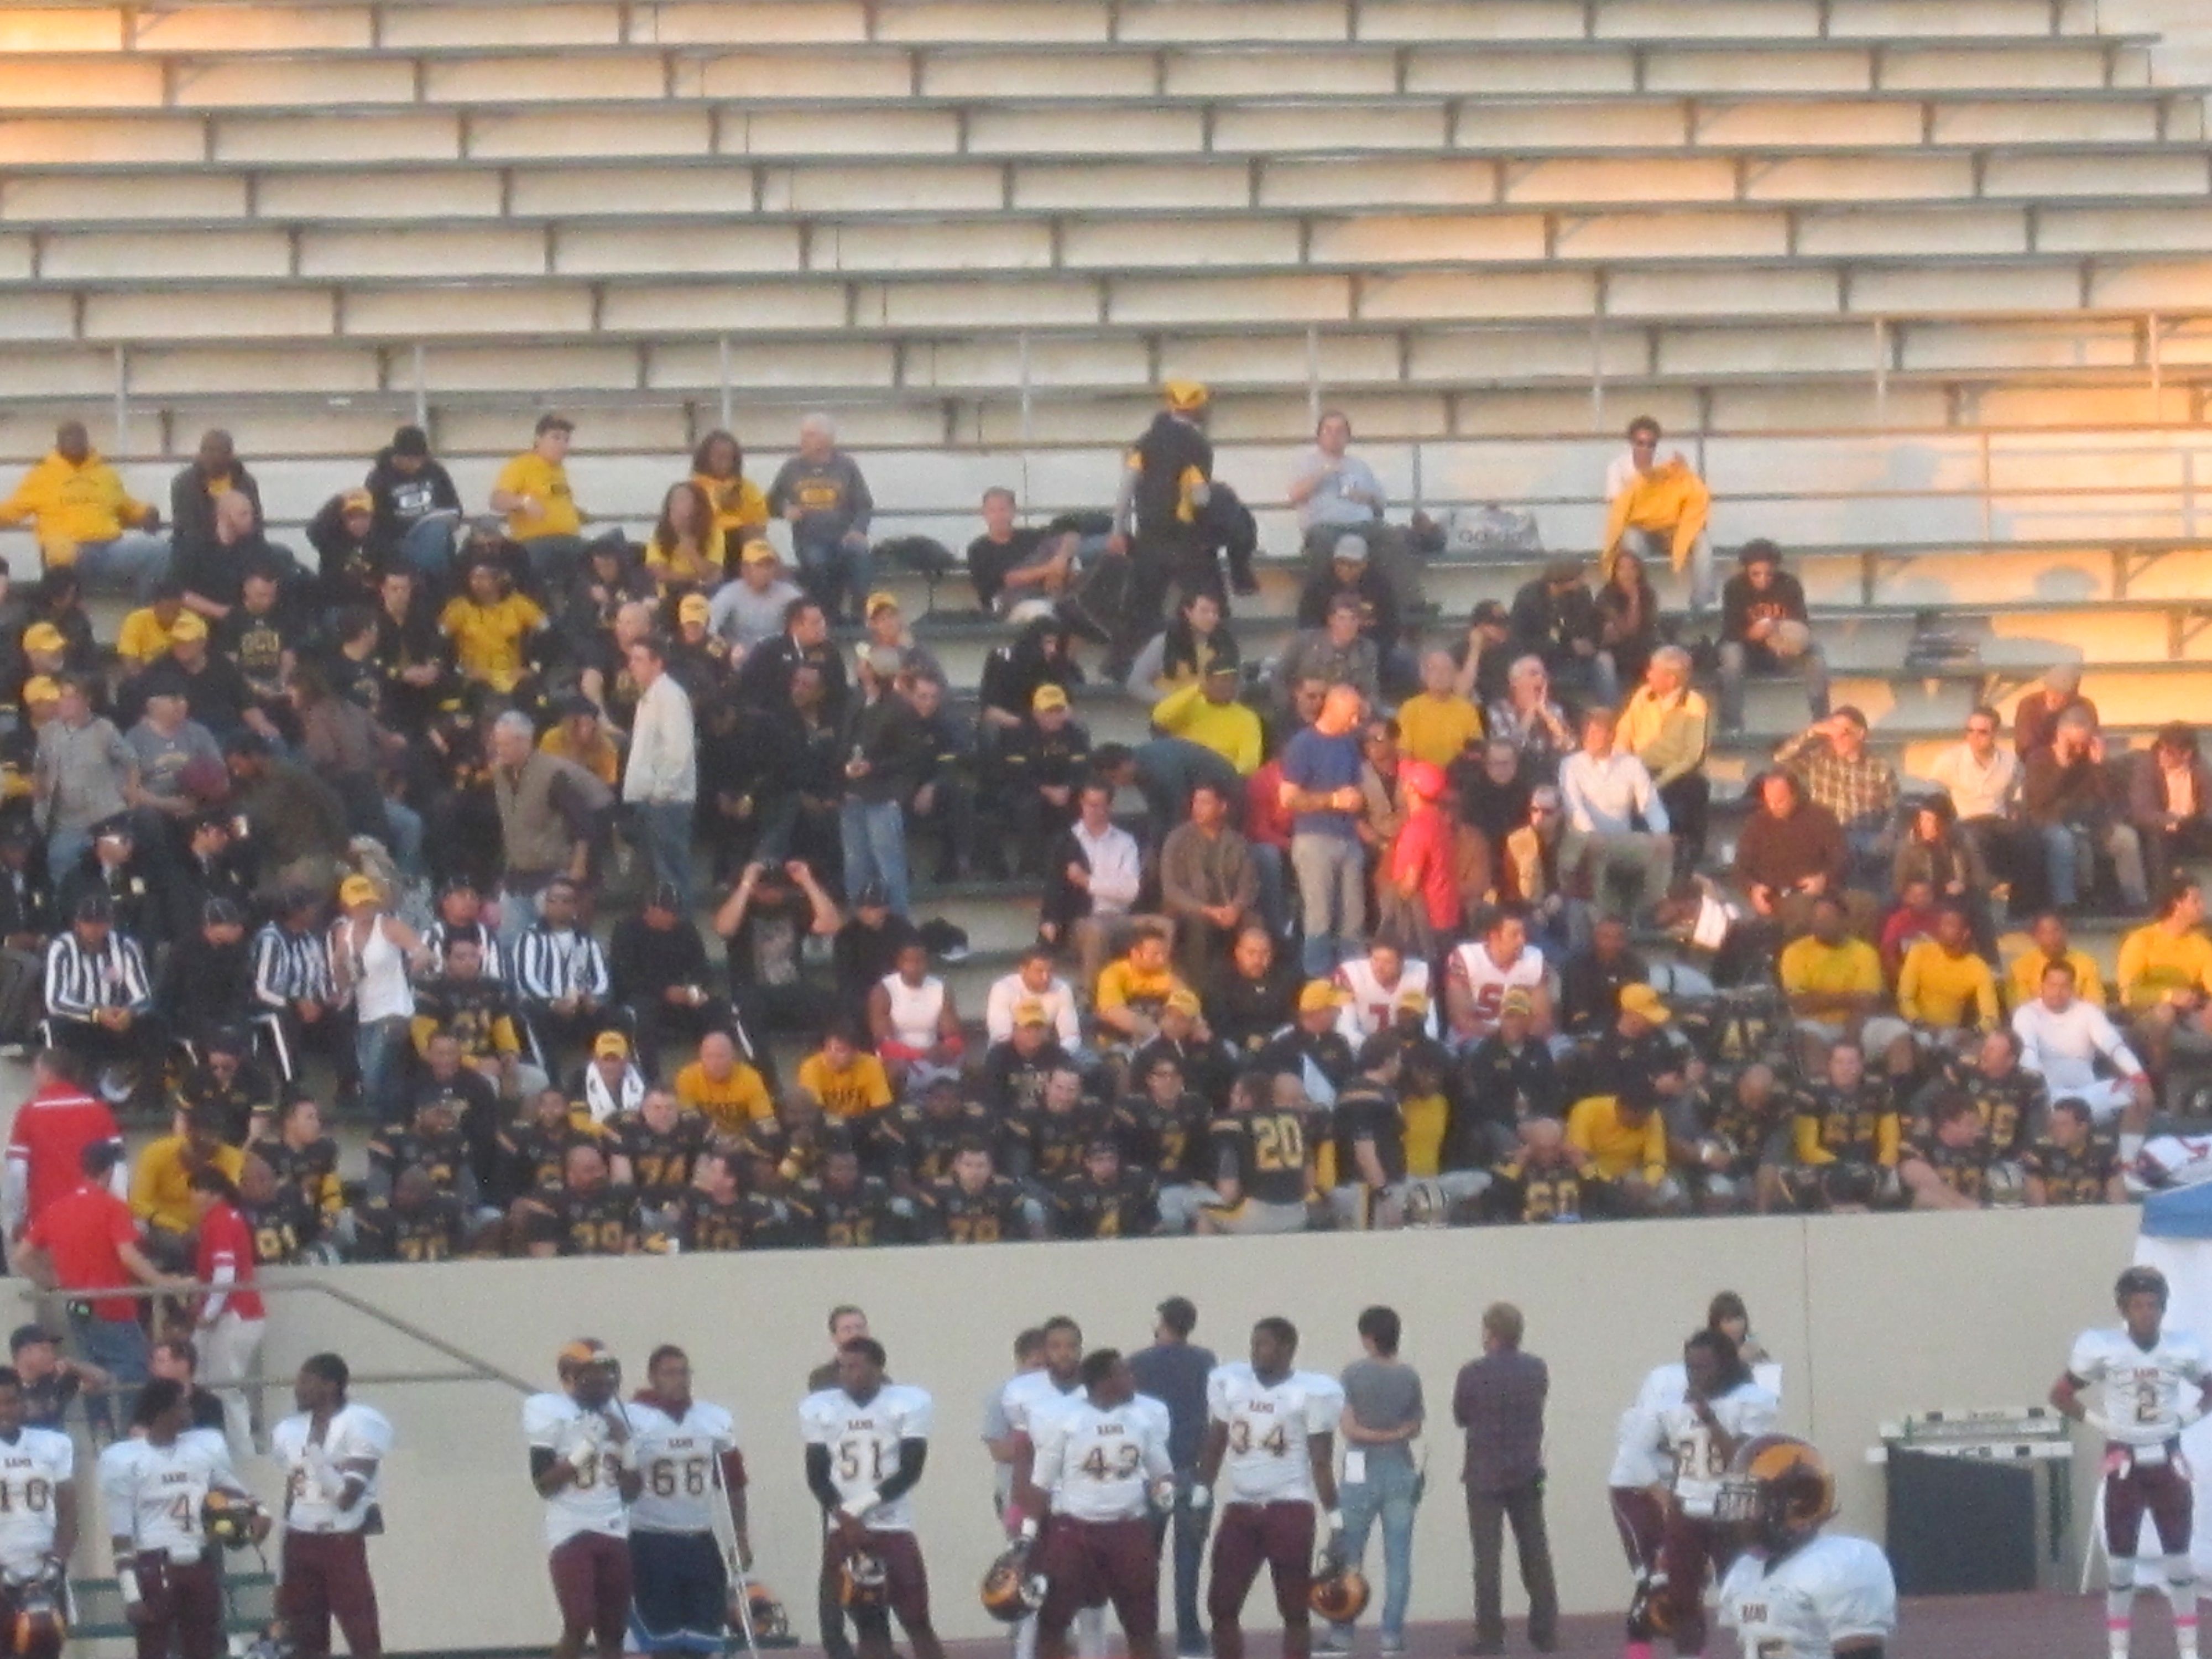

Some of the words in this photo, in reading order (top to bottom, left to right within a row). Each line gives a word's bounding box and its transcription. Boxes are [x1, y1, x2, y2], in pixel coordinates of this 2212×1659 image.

[1251, 1114, 1304, 1170] 20
[2136, 1382, 2158, 1422] 2
[1231, 1419, 1286, 1458] 34
[839, 1439, 883, 1481] 51
[170, 1493, 192, 1533] 4
